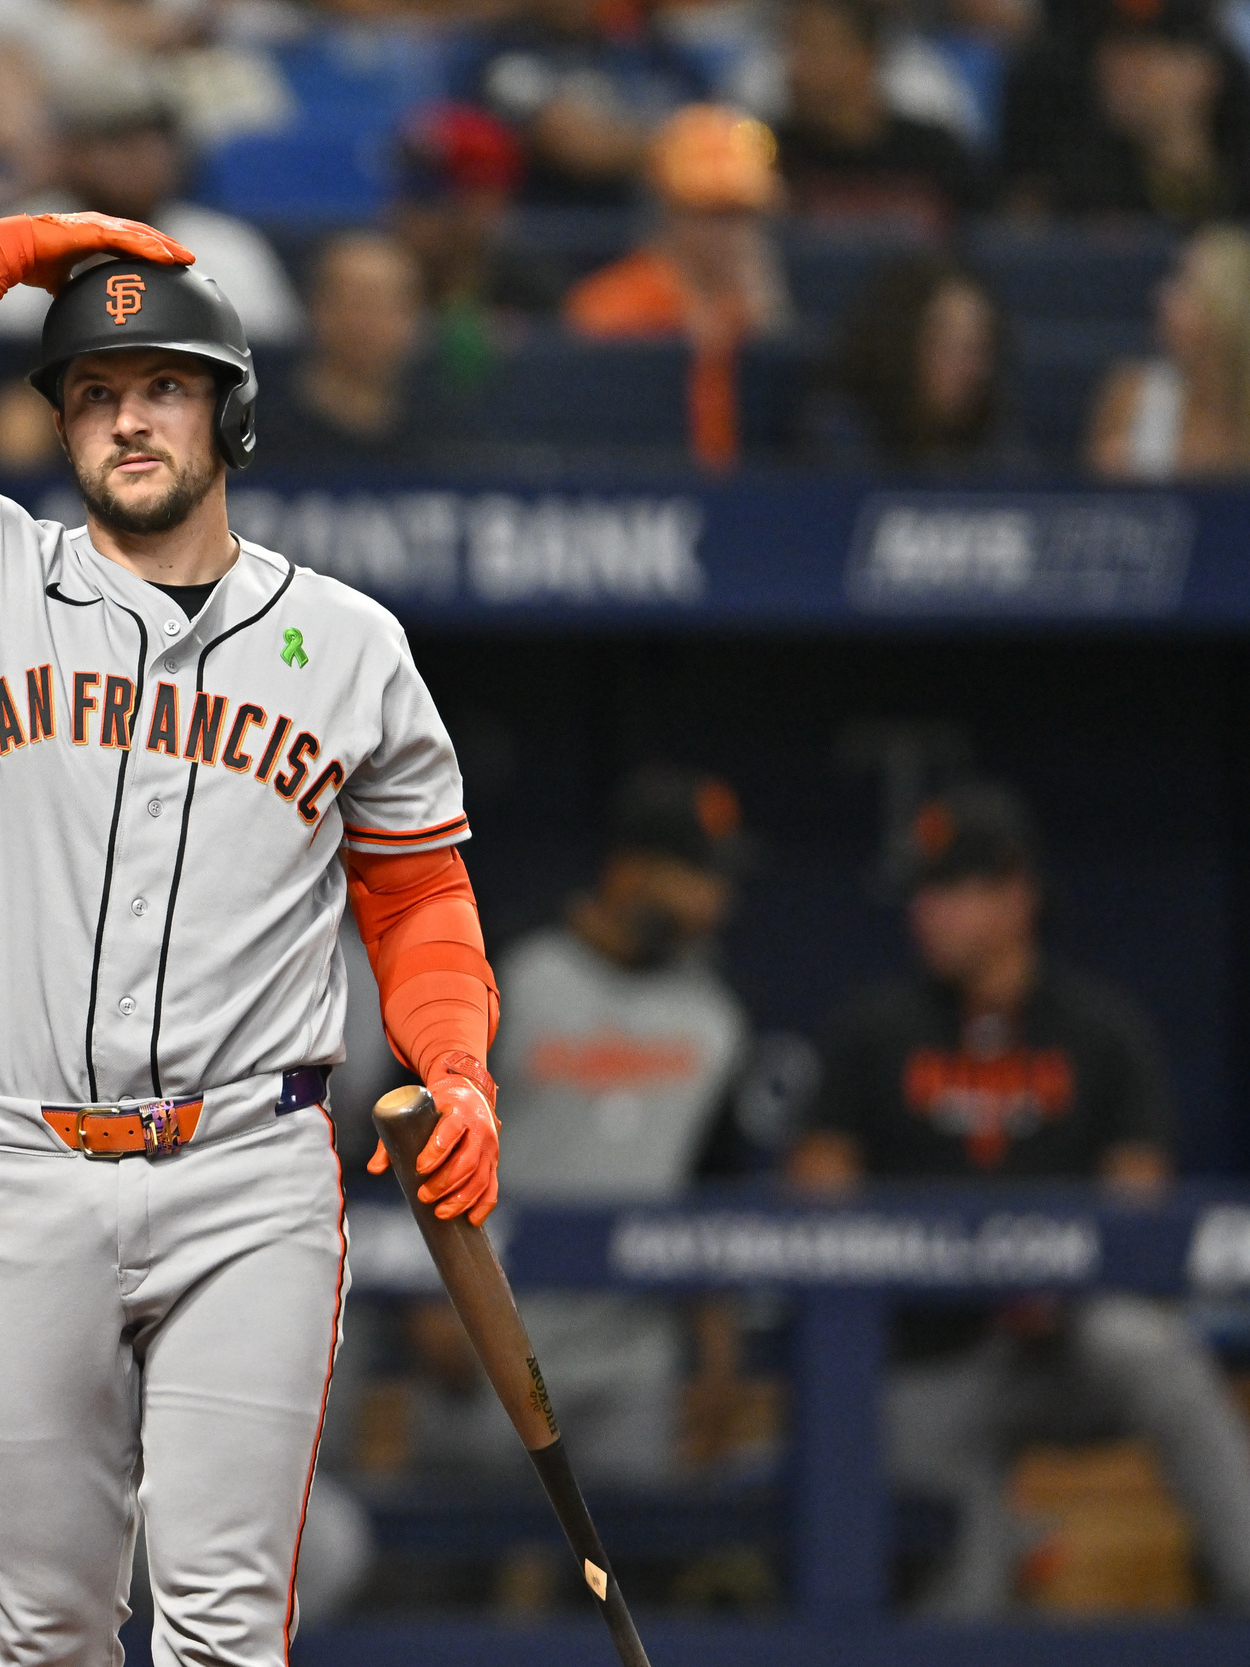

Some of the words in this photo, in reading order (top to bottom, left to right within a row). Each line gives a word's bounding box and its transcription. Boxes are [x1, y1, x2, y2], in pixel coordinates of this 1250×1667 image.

[106, 273, 146, 325] SF
[468, 494, 707, 604] BANK
[72, 671, 346, 828] FRANCISC
[526, 1356, 559, 1435] HICKORY
[530, 1391, 542, 1412] OLD
